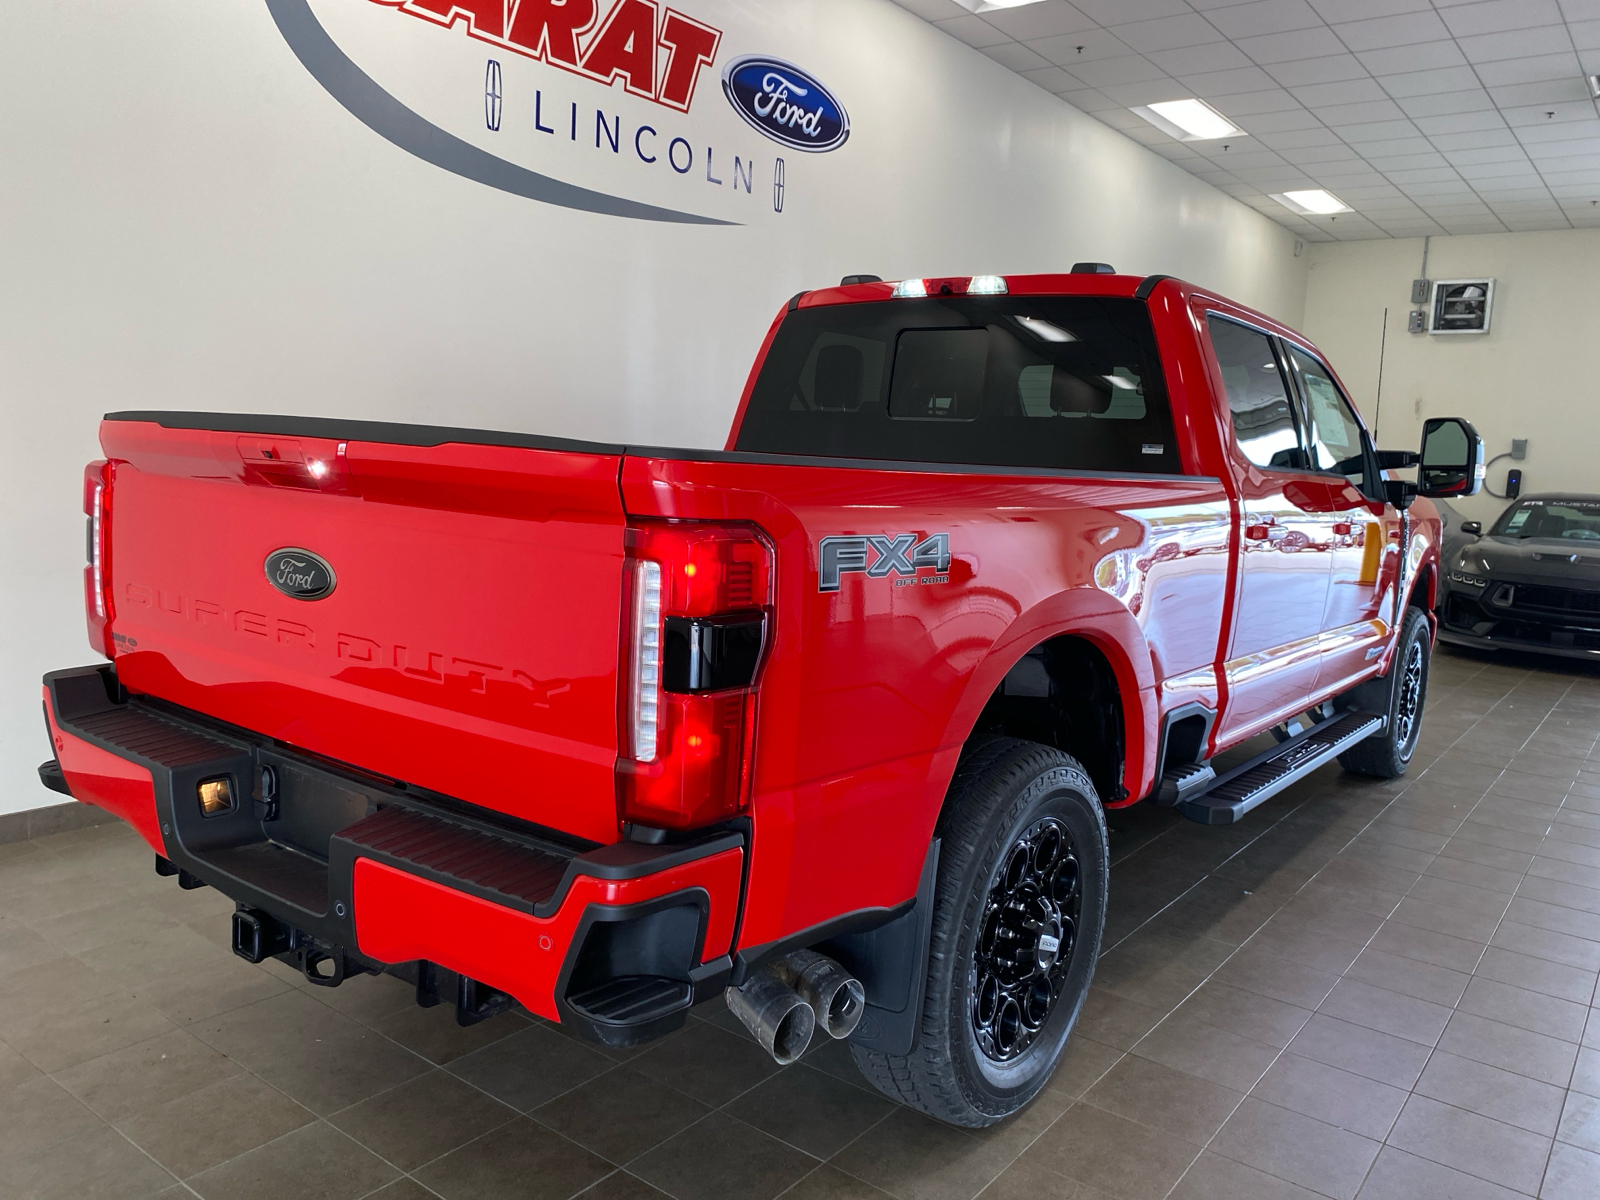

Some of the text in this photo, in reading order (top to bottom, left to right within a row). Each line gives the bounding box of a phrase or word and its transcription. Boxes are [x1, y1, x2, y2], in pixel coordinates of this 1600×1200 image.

[367, 0, 723, 114] RAT
[753, 72, 824, 137] Ford
[533, 90, 753, 194] LINCOLN
[276, 558, 316, 590] Ford
[818, 533, 951, 593] FX4
[895, 576, 949, 587] OFF ROAD
[126, 583, 571, 709] SUPER DUTY
